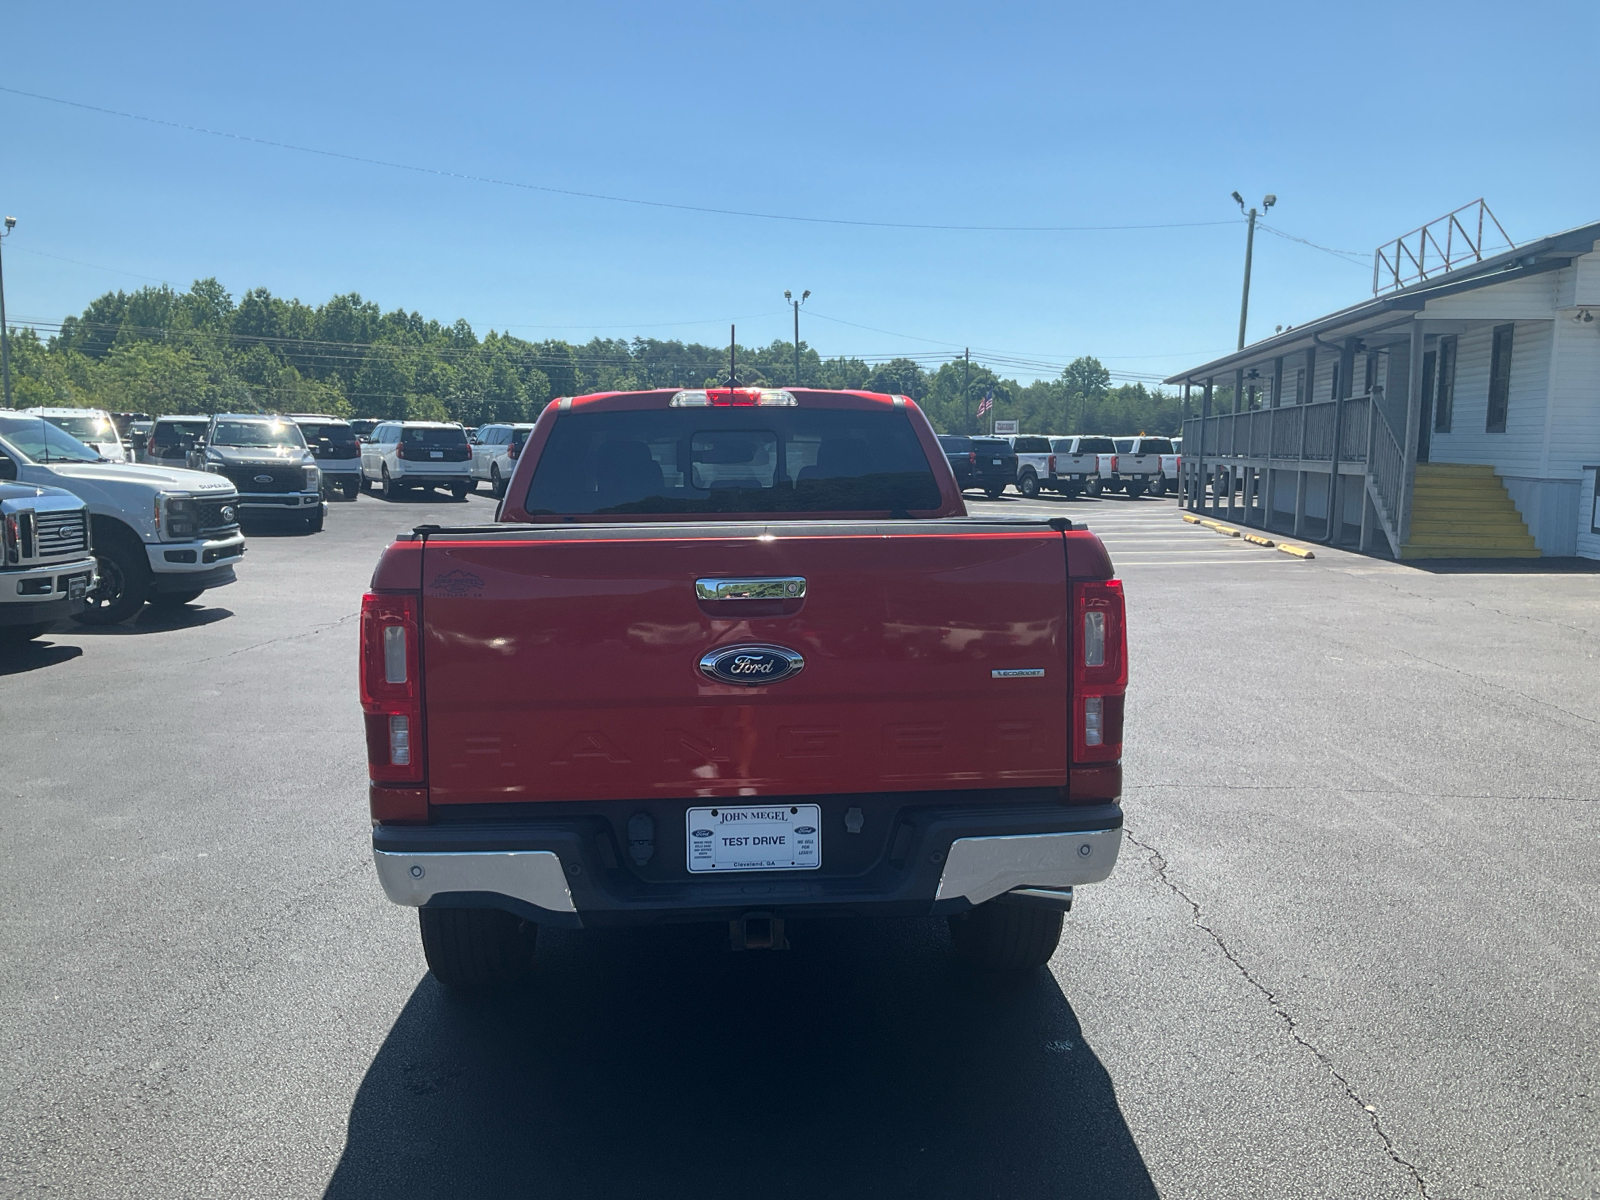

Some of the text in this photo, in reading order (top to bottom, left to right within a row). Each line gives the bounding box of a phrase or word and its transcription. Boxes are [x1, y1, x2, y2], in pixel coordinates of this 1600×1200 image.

[731, 655, 774, 674] Ford
[720, 811, 788, 824] JOHN MEGEL
[722, 835, 786, 846] TEST DRIVE
